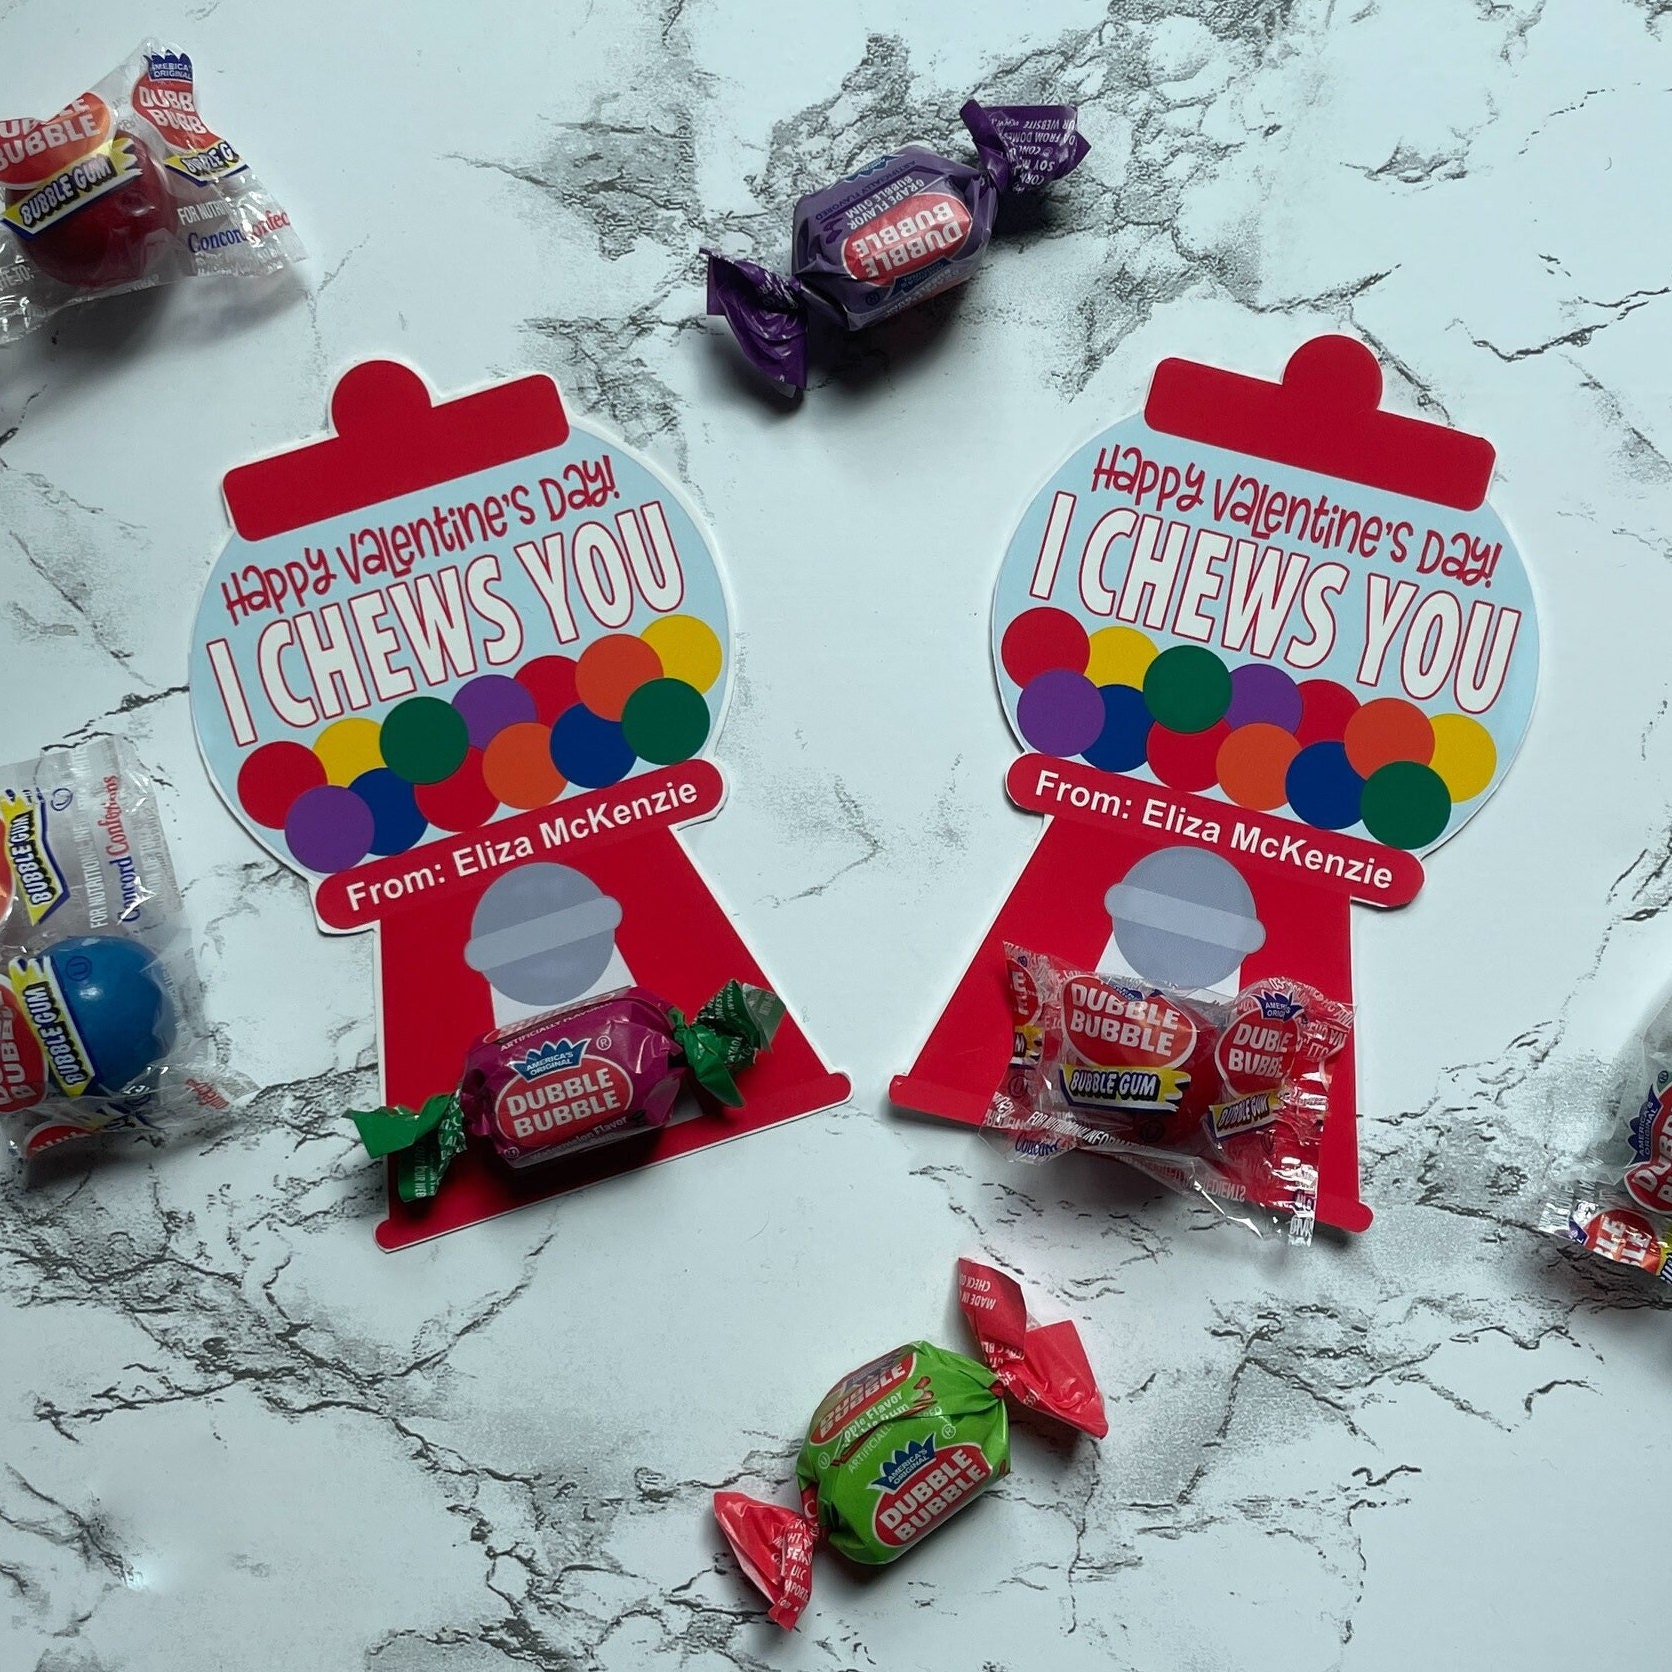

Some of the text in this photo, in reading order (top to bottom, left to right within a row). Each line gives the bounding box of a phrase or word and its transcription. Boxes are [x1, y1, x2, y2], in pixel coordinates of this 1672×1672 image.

[1023, 119, 1059, 131] WEBSITE
[1034, 159, 1055, 172] SOY
[20, 155, 113, 227] BUBBLE GUM
[844, 175, 914, 219] BUBBLE GUM
[845, 178, 926, 231] GRAPE FLAVOR
[851, 201, 955, 258] BUBBLE
[860, 220, 963, 279] DUBBLE
[1091, 444, 1205, 512] Happy
[1417, 528, 1503, 588] Day!
[221, 547, 337, 626] Happy
[539, 455, 620, 522] Day!
[206, 501, 684, 747] I CHEWS YOU
[1029, 490, 1521, 714] I CHEWS YOU
[346, 781, 697, 911] From: Eliza McKenzie
[1036, 769, 1393, 889] From: Eliza McKenzie
[11, 844, 55, 905] BUBBLE
[90, 907, 108, 929] FOR
[24, 984, 57, 1022] GUM
[1071, 983, 1180, 1031] DUBBLE
[37, 1020, 85, 1086] BUBBLE
[501, 1021, 562, 1051] ARTIFICIALLY
[1070, 1011, 1175, 1057] BUBBLE
[526, 1051, 575, 1072] AMERICA'S
[529, 1057, 572, 1076] ORIGINAL
[1071, 1068, 1158, 1098] BUBBLE GUM
[506, 1068, 614, 1117] DUBBLE
[513, 1090, 621, 1139] BUBBLE
[1217, 1098, 1252, 1129] BUBBLE
[593, 1115, 628, 1139] Flavor
[1026, 1111, 1048, 1127] FOR
[961, 1293, 997, 1311] MADE IN
[864, 1387, 905, 1422] Flavor
[879, 1449, 972, 1530] DUBBLE
[888, 1449, 928, 1484] AMERICA'S
[893, 1456, 930, 1486] ORIGINAL
[893, 1463, 986, 1542] BUBBLE
